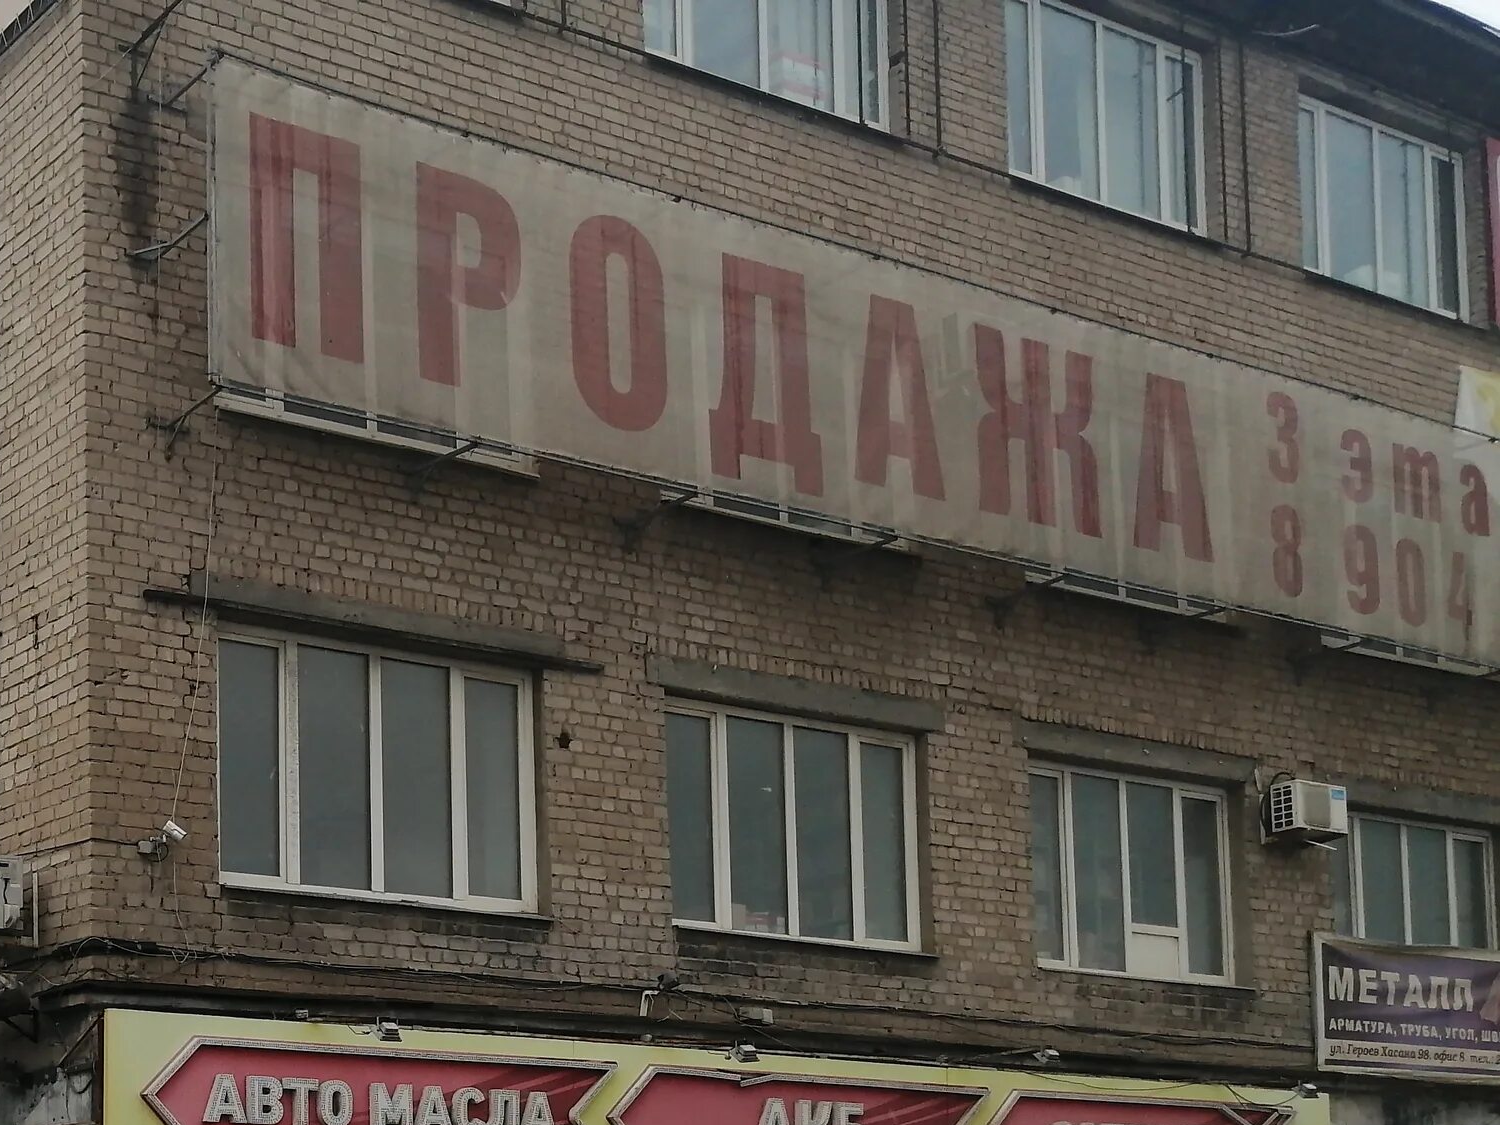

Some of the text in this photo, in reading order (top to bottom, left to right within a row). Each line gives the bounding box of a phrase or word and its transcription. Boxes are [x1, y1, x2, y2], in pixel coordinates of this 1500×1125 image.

[249, 112, 1215, 562] ПРОДАЖА
[1266, 391, 1300, 484] 3
[1328, 965, 1474, 1012] МЕТАЛЛ
[1328, 1018, 1397, 1037] АРМАТУРА,
[1401, 1023, 1442, 1041] ТРУБА,
[1445, 1027, 1478, 1044] УГОЛ,
[1329, 1045, 1345, 1057] ул.
[1347, 1044, 1379, 1058] Героев
[1380, 1046, 1416, 1059] Хасана
[1434, 1051, 1457, 1063] офис
